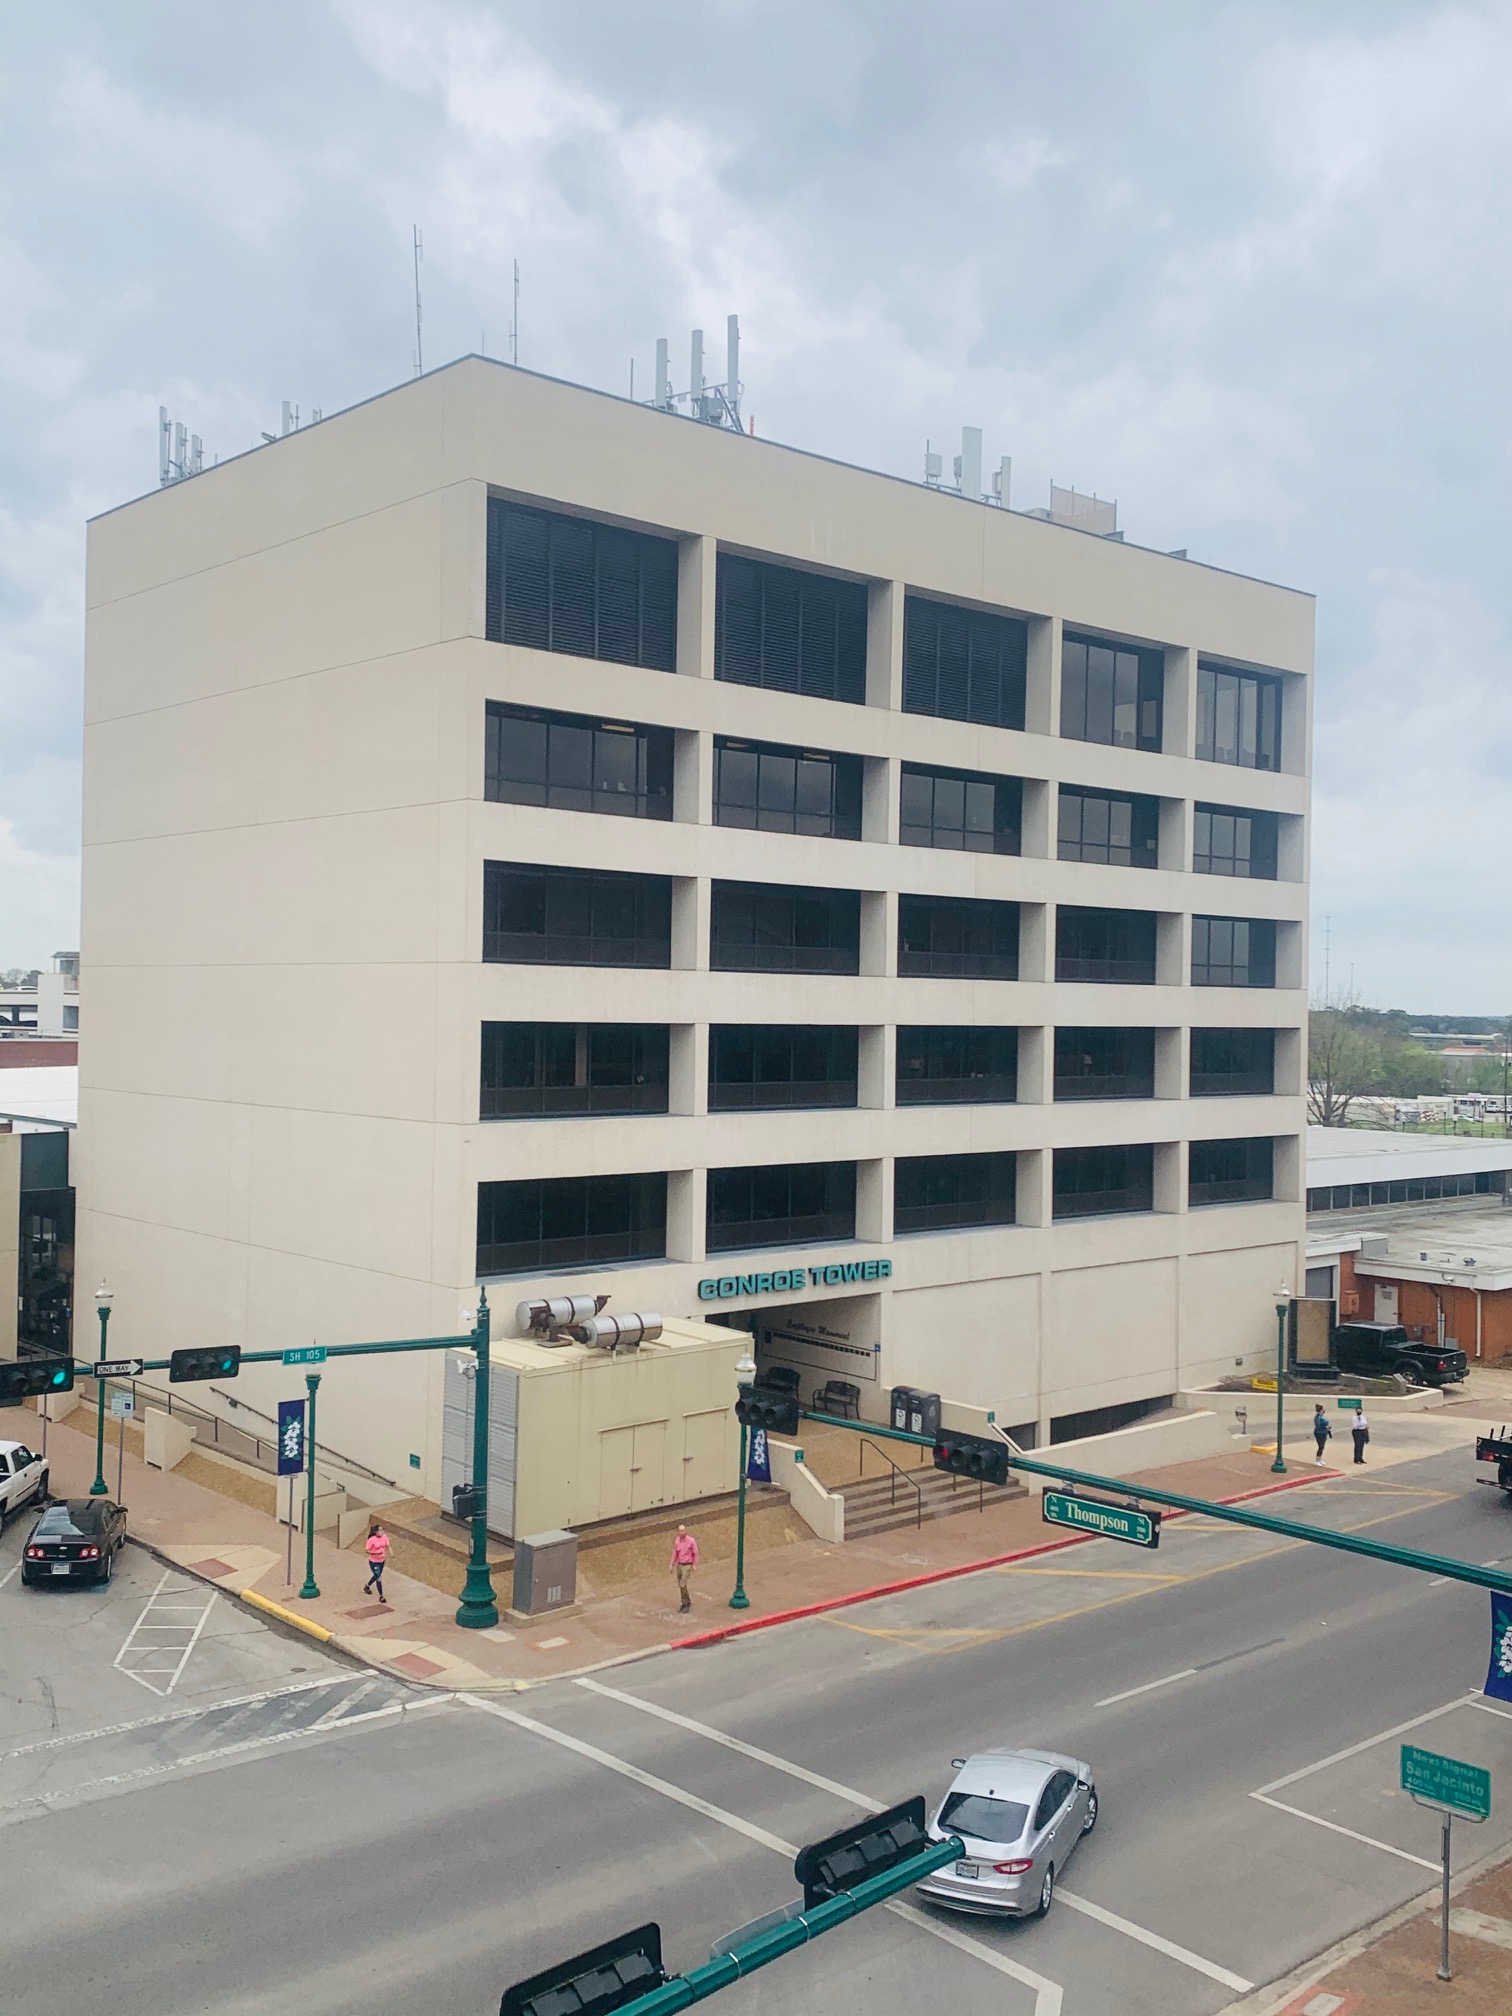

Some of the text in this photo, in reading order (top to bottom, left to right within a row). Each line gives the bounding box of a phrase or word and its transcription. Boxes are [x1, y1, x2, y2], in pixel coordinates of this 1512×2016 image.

[698, 1259, 892, 1300] CONROE TOWER
[115, 1364, 129, 1372] WAY
[290, 1350, 320, 1361] SH 105
[1065, 1502, 1129, 1532] Thompson
[1406, 1761, 1430, 1779] San
[1433, 1771, 1484, 1796] Jacinto
[1413, 1750, 1478, 1778] Next Signal
